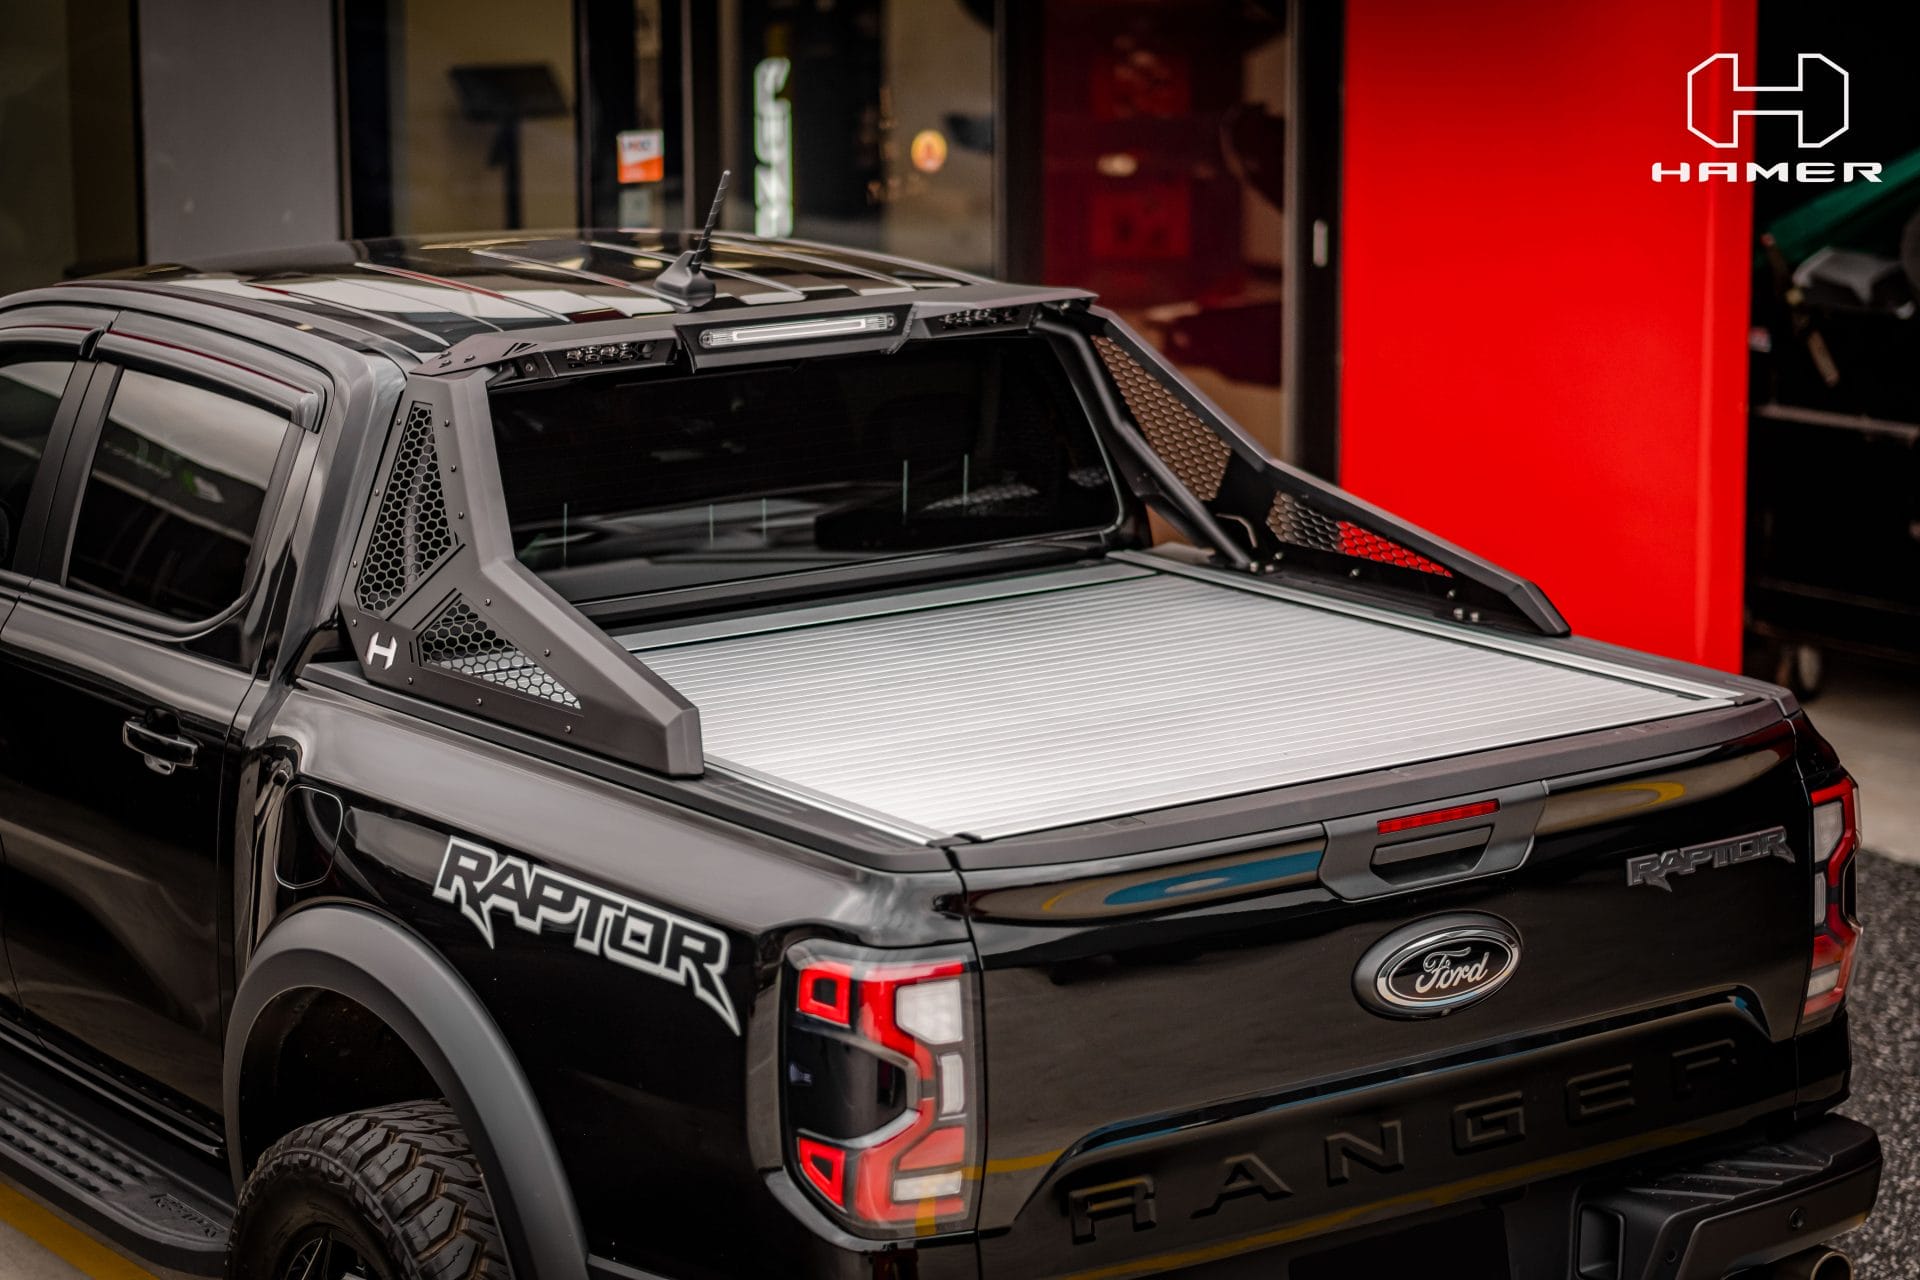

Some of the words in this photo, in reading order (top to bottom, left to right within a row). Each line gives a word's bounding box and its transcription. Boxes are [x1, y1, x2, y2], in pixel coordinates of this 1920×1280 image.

[1627, 825, 1796, 893] RAPTOR
[433, 835, 741, 1036] RAPTOR
[1415, 946, 1491, 994] Ford
[1067, 1037, 1737, 1246] RANGER
